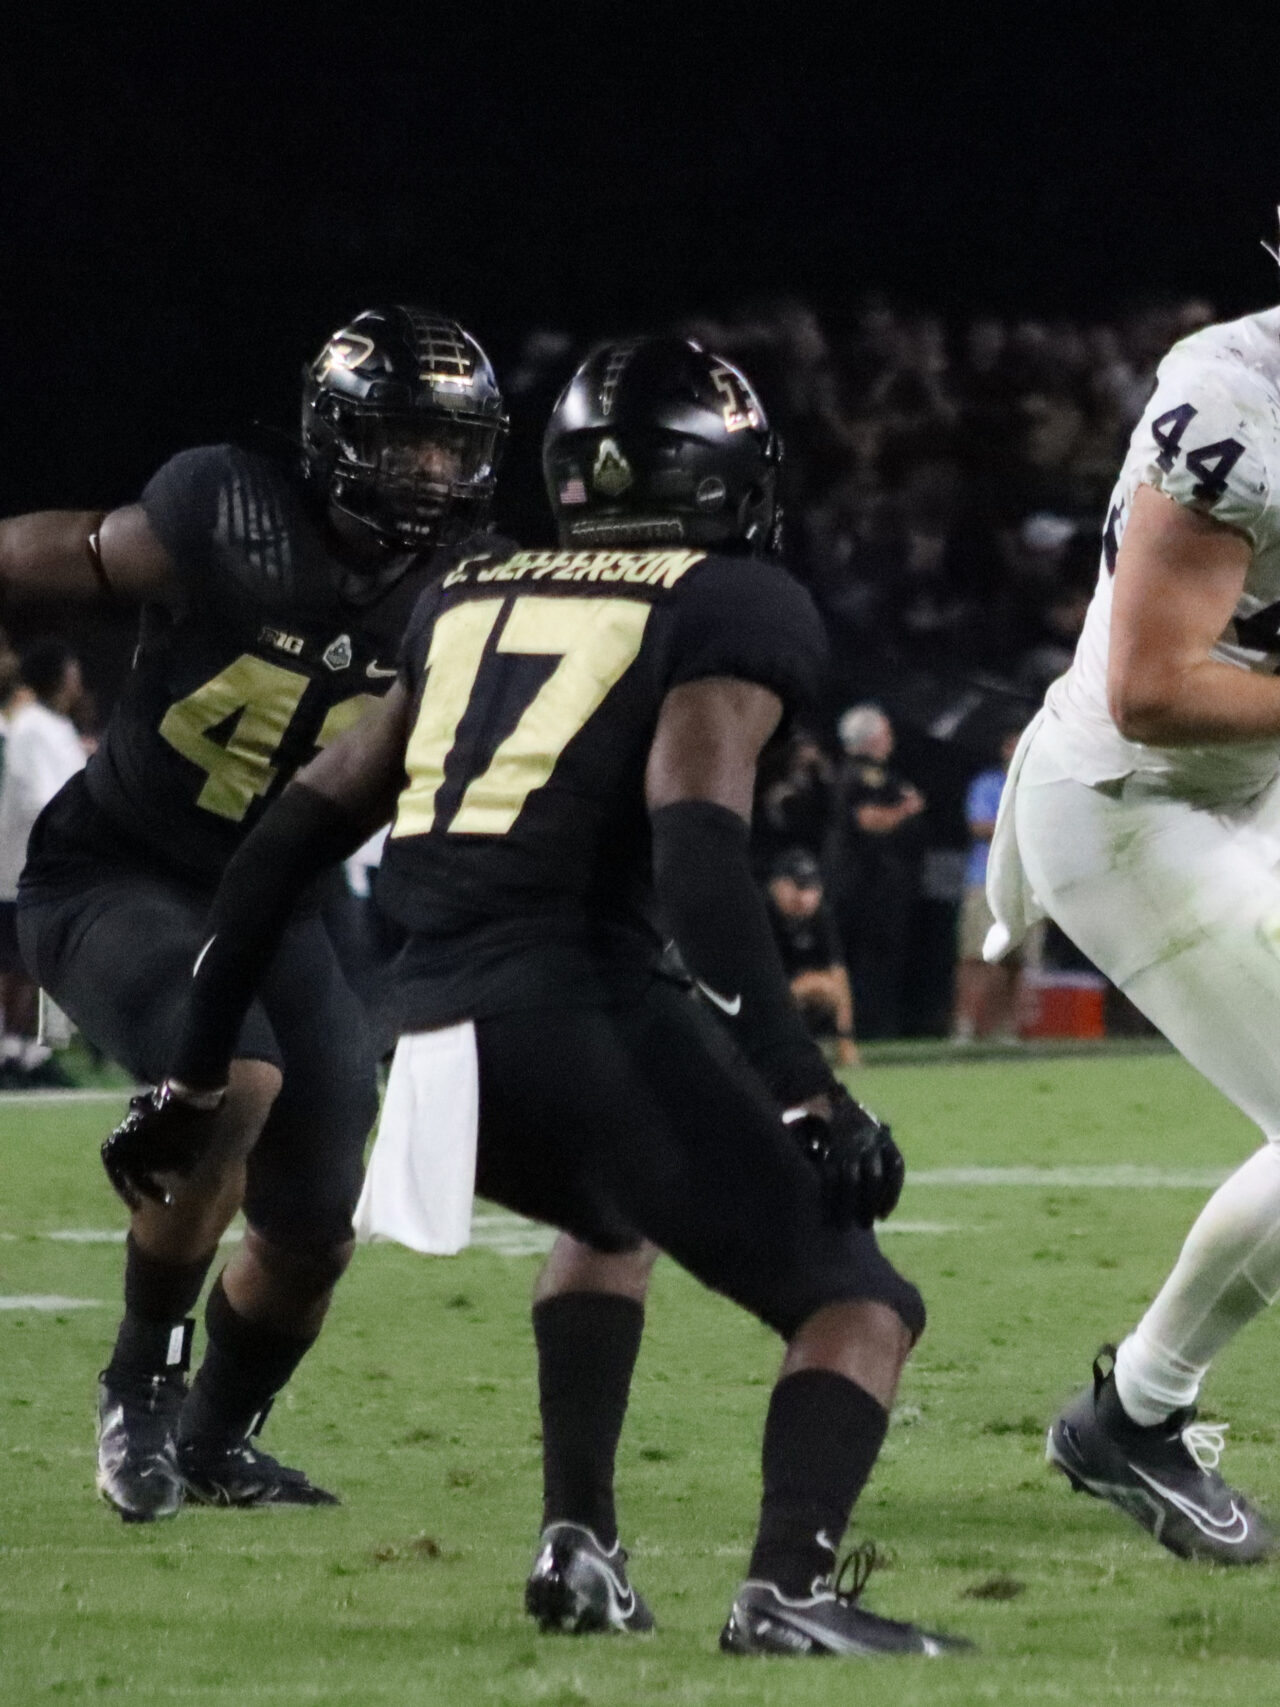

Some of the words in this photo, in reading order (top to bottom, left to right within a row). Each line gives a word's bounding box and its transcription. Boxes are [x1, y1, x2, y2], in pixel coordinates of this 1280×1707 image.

[1151, 402, 1246, 503] 44
[477, 551, 707, 589] JEFFERSON
[390, 596, 652, 838] 17
